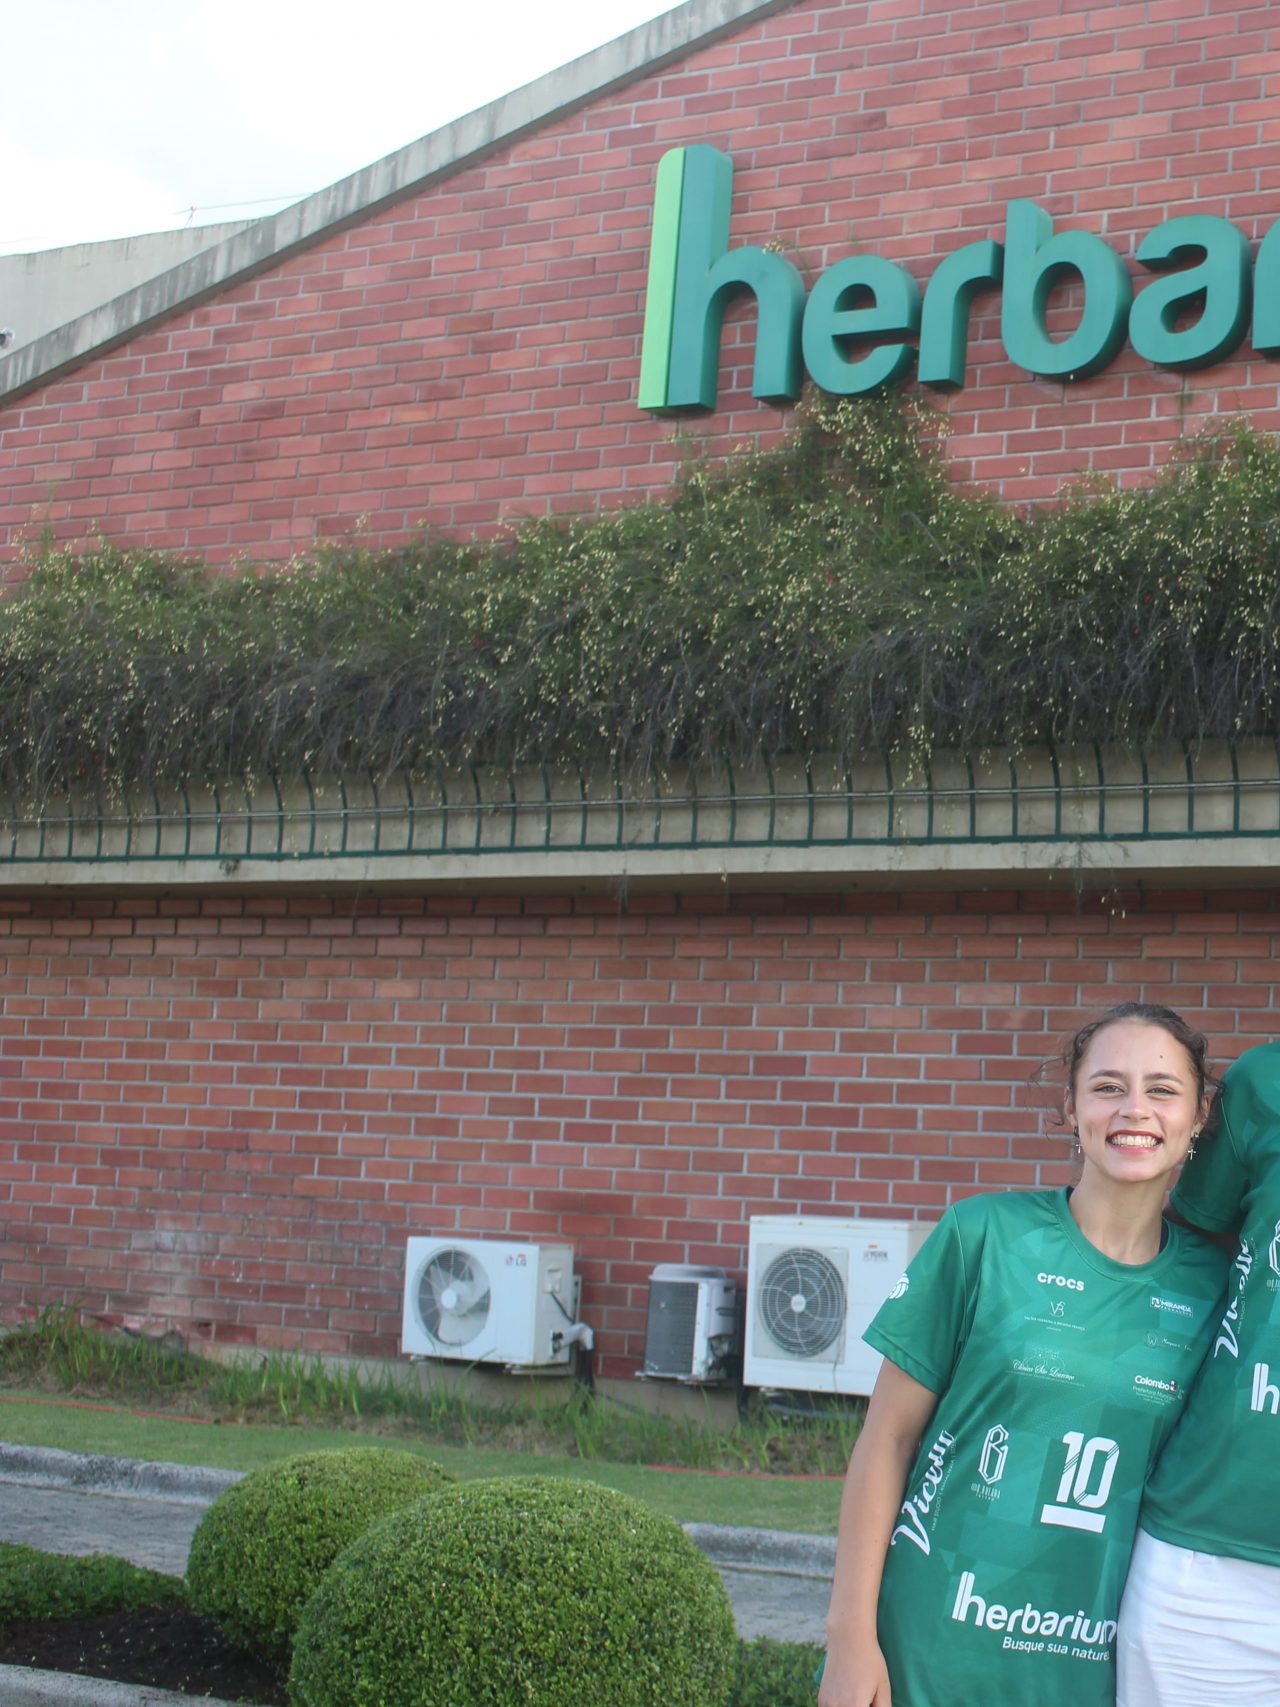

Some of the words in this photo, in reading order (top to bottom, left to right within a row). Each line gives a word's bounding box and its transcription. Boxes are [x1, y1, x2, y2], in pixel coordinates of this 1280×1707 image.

[1037, 1272, 1085, 1291] crocs
[1134, 1375, 1170, 1391] Colombo
[1060, 1431, 1120, 1509] 10
[1002, 1637, 1045, 1653] Busque
[1047, 1642, 1068, 1655] sua
